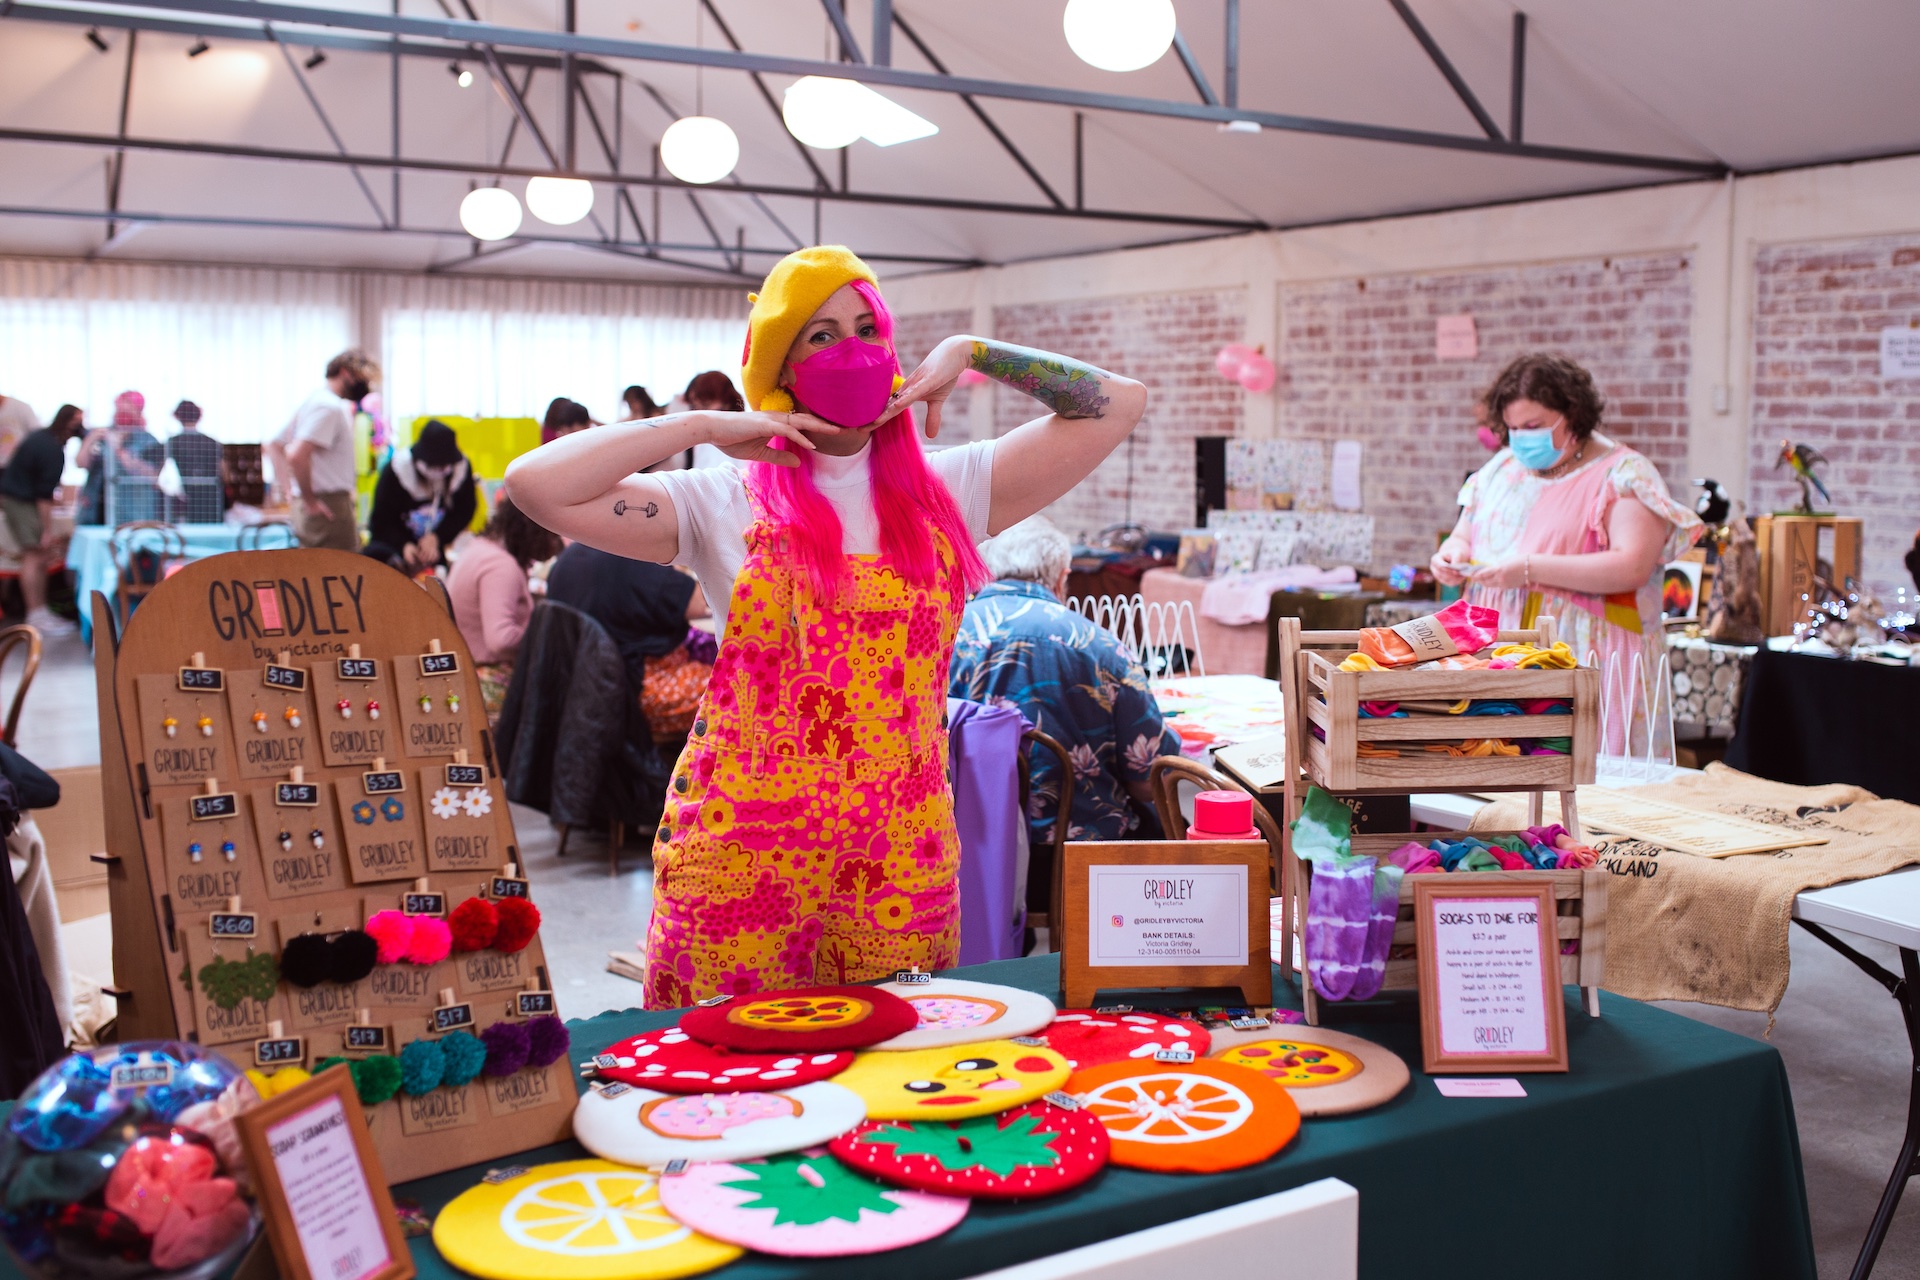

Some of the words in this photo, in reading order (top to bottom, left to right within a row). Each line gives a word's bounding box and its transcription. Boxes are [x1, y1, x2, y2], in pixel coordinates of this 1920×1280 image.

[251, 640, 276, 661] by
[343, 661, 372, 676] $15
[425, 657, 450, 671] $15
[183, 671, 214, 685] $15
[267, 668, 295, 684] $15
[367, 774, 398, 790] $35
[450, 767, 477, 782] $35
[280, 785, 310, 801] $15
[196, 797, 226, 815] $15
[495, 881, 522, 895] $17
[408, 897, 435, 911] $17
[214, 917, 252, 933] $60
[1439, 913, 1473, 925] SOCKS
[1476, 913, 1491, 925] TO
[1517, 912, 1538, 925] FOR
[1170, 940, 1192, 948] Gridley
[898, 972, 930, 983] $120
[521, 995, 544, 1011] $17
[438, 1009, 464, 1026] $17
[349, 1029, 376, 1045] $17
[260, 1041, 293, 1061] $17
